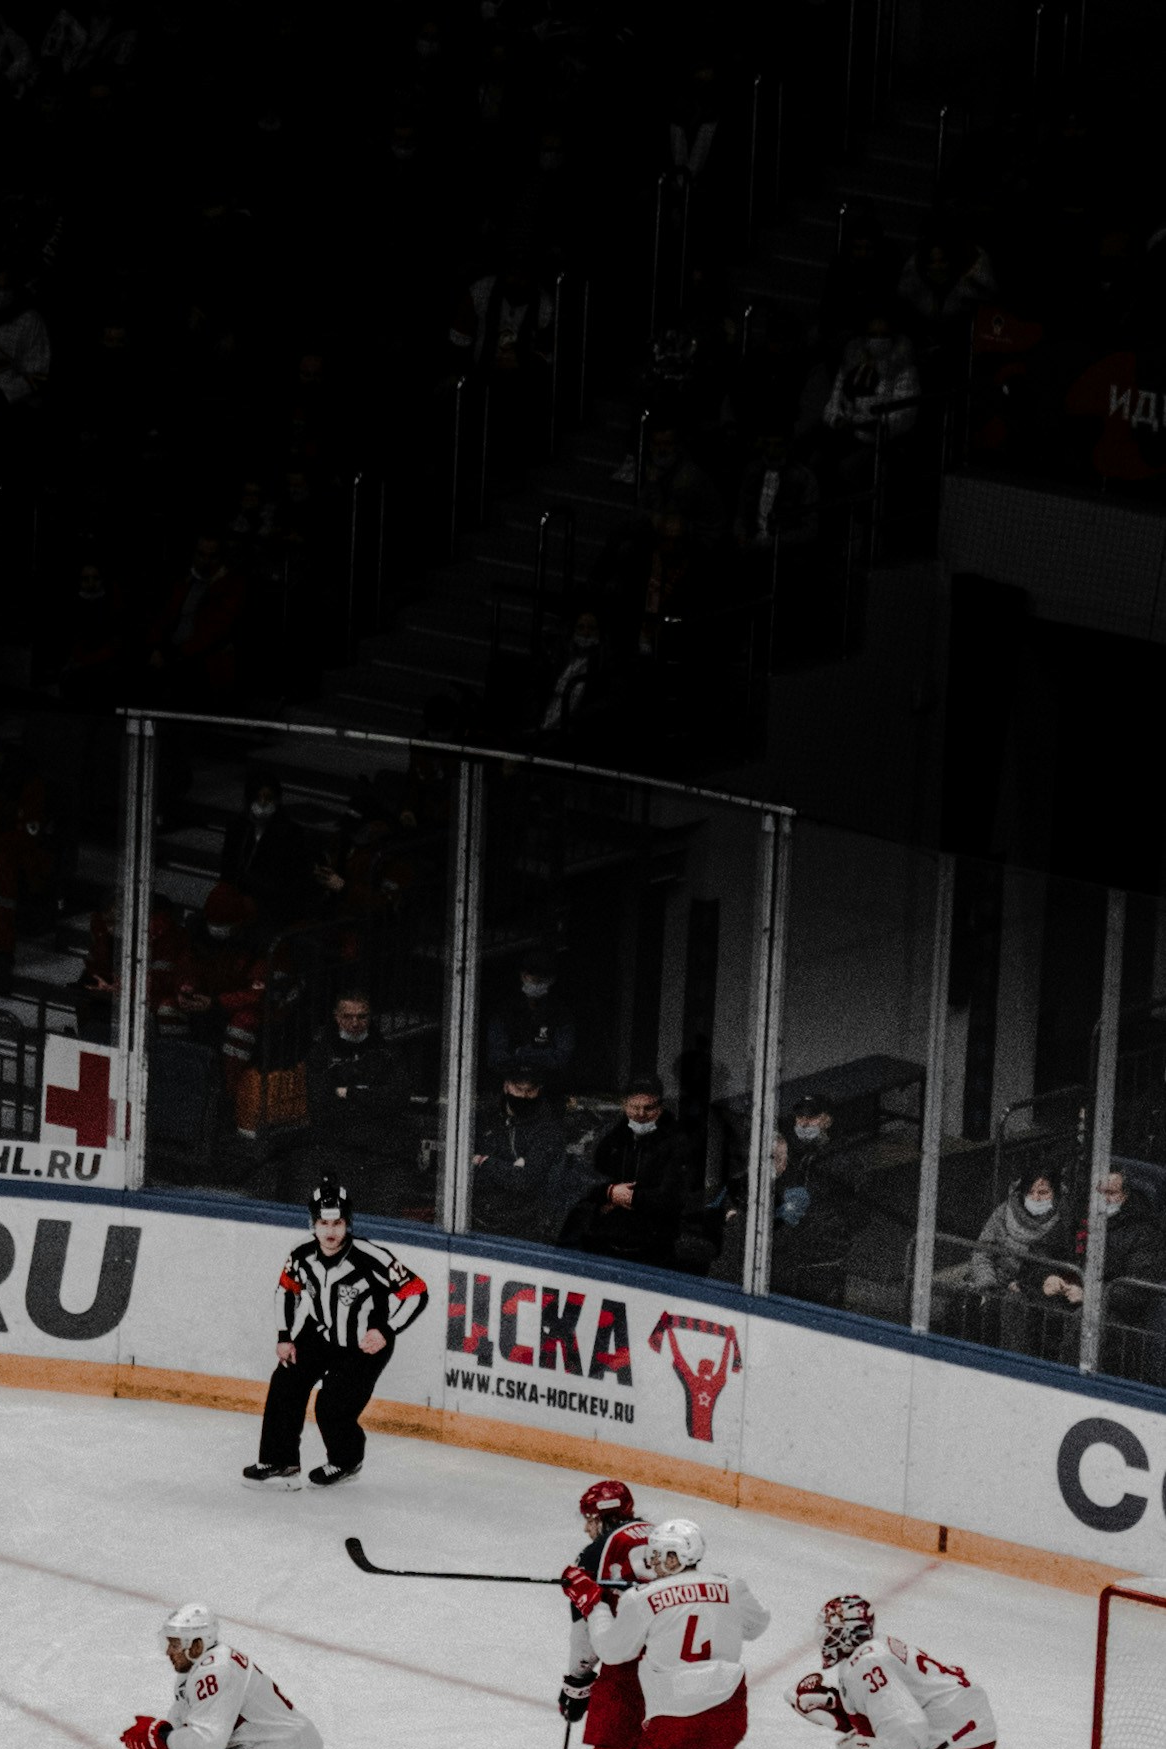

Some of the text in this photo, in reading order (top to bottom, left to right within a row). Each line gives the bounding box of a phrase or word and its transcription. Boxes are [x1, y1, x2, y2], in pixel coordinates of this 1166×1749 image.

[388, 1262, 410, 1287] 42
[446, 1269, 633, 1386] ЦСКА
[446, 1369, 633, 1424] WWW.CSKA-HOCKEY.RU
[650, 1583, 729, 1613] SOKOLOV
[195, 1674, 219, 1701] 28
[863, 1666, 887, 1693] 33
